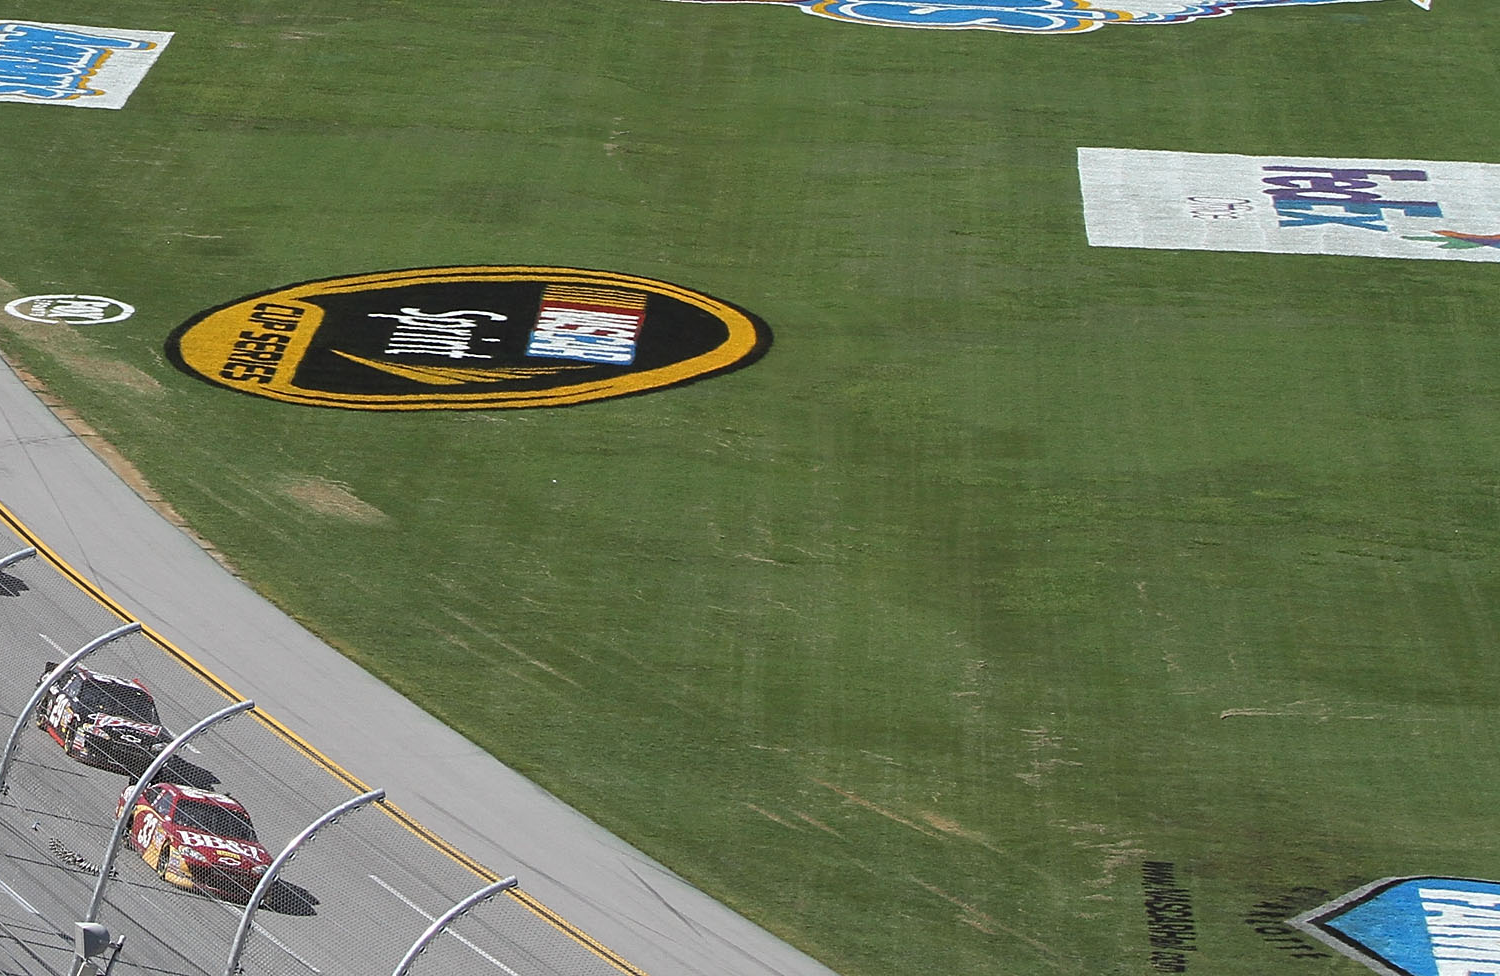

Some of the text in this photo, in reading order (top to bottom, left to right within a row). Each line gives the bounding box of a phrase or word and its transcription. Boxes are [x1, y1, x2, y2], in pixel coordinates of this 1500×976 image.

[1187, 195, 1254, 222] Office
[1262, 165, 1444, 232] FedEx
[47, 299, 111, 320] FOX
[367, 307, 509, 360] Sprint
[528, 307, 640, 362] NASCAR
[219, 303, 305, 384] CUP SERIES
[176, 829, 263, 862] BB&T
